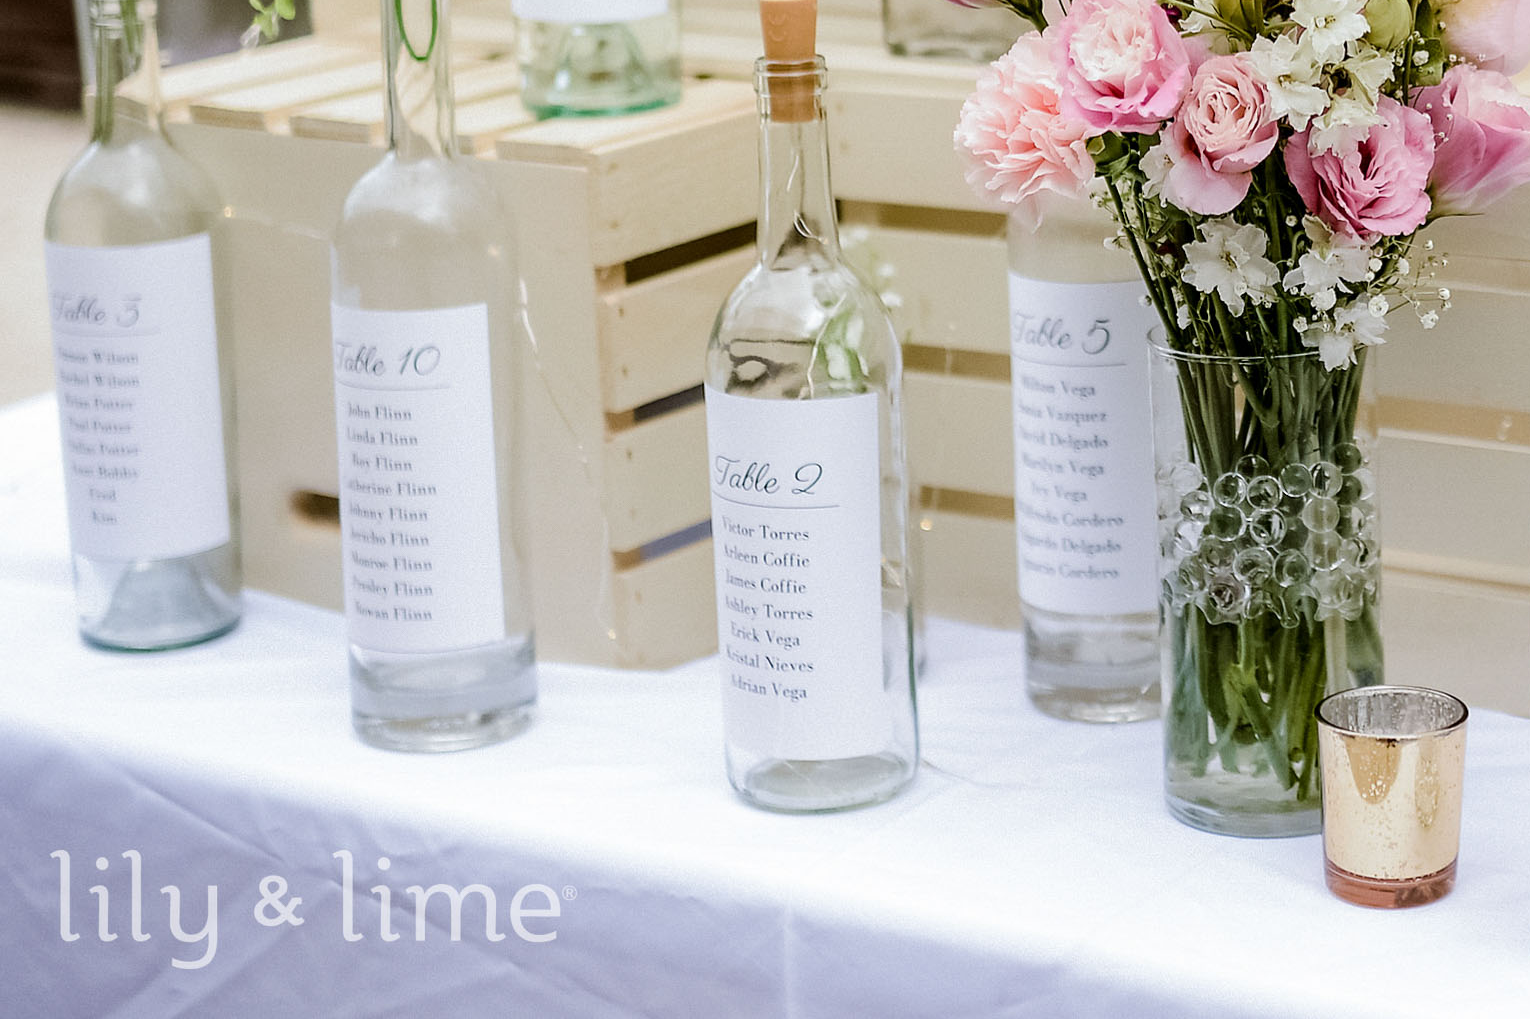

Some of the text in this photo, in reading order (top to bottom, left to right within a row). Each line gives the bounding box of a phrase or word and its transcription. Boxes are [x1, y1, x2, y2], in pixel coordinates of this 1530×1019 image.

[1082, 319, 1110, 355] 5
[335, 341, 441, 377] Table 10
[375, 406, 412, 421] Flinn
[380, 432, 418, 445] Flinn
[715, 455, 822, 495] Table 2
[759, 525, 809, 541] Torres
[763, 552, 810, 568] Coffie
[761, 578, 807, 594] Coffie
[763, 604, 814, 620] Torres
[766, 630, 800, 650] Vega
[765, 655, 814, 672] Nieves
[772, 683, 807, 702] Vega
